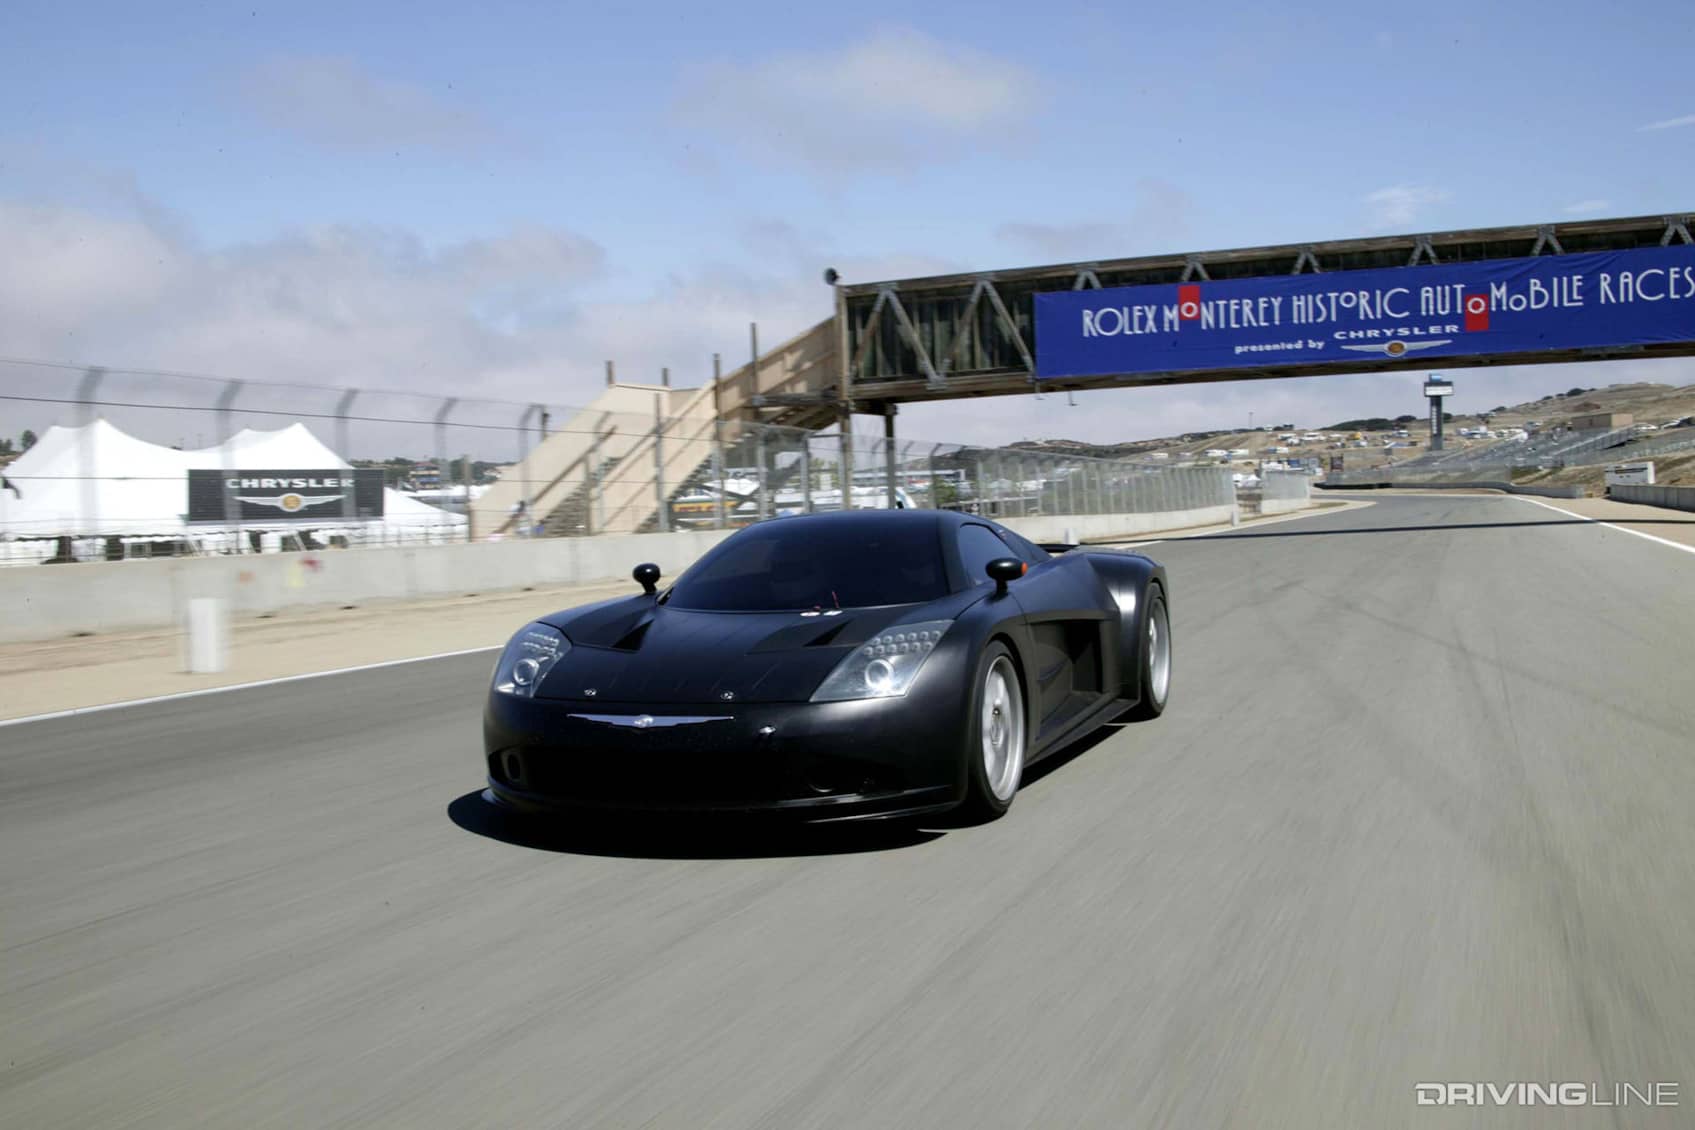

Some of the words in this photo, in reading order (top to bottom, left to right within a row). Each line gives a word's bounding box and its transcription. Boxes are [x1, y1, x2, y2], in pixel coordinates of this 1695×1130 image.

[1082, 305, 1158, 338] ROLEX
[1600, 266, 1695, 306] RACES
[1234, 340, 1303, 355] presented
[1308, 338, 1325, 350] by
[1333, 324, 1459, 341] CHRYSLER
